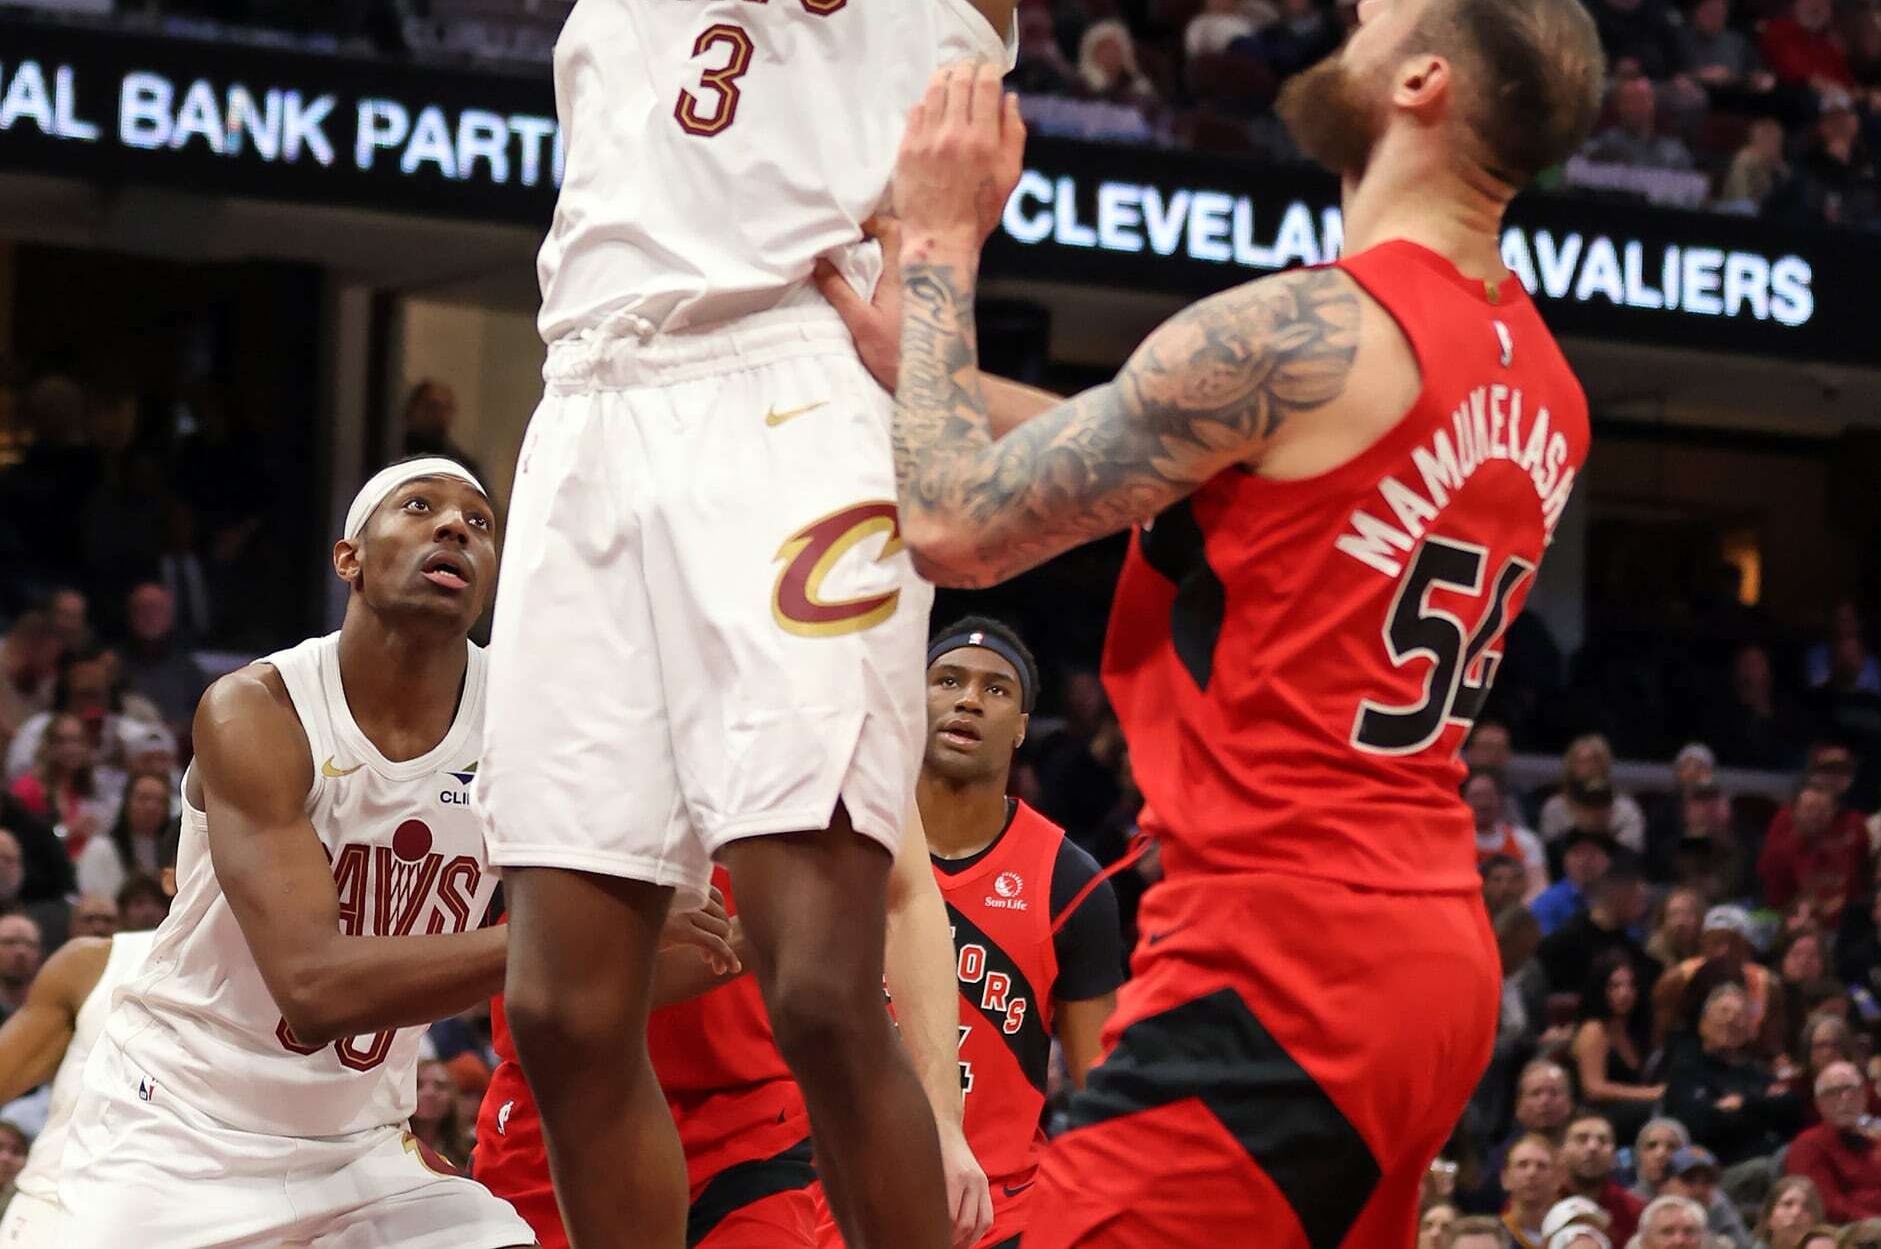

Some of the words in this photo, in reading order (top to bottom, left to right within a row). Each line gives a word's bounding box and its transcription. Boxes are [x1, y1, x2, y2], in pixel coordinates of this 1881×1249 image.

[0, 59, 102, 140] AL
[120, 69, 337, 167] BANK
[355, 97, 566, 188] PART
[674, 23, 754, 138] 3
[1335, 383, 1576, 579] MAMUKELASH
[1349, 534, 1537, 757] 54
[322, 841, 482, 936] AVS
[984, 896, 1006, 908] Sun
[1007, 899, 1027, 910] Life
[950, 926, 1026, 1035] ORS
